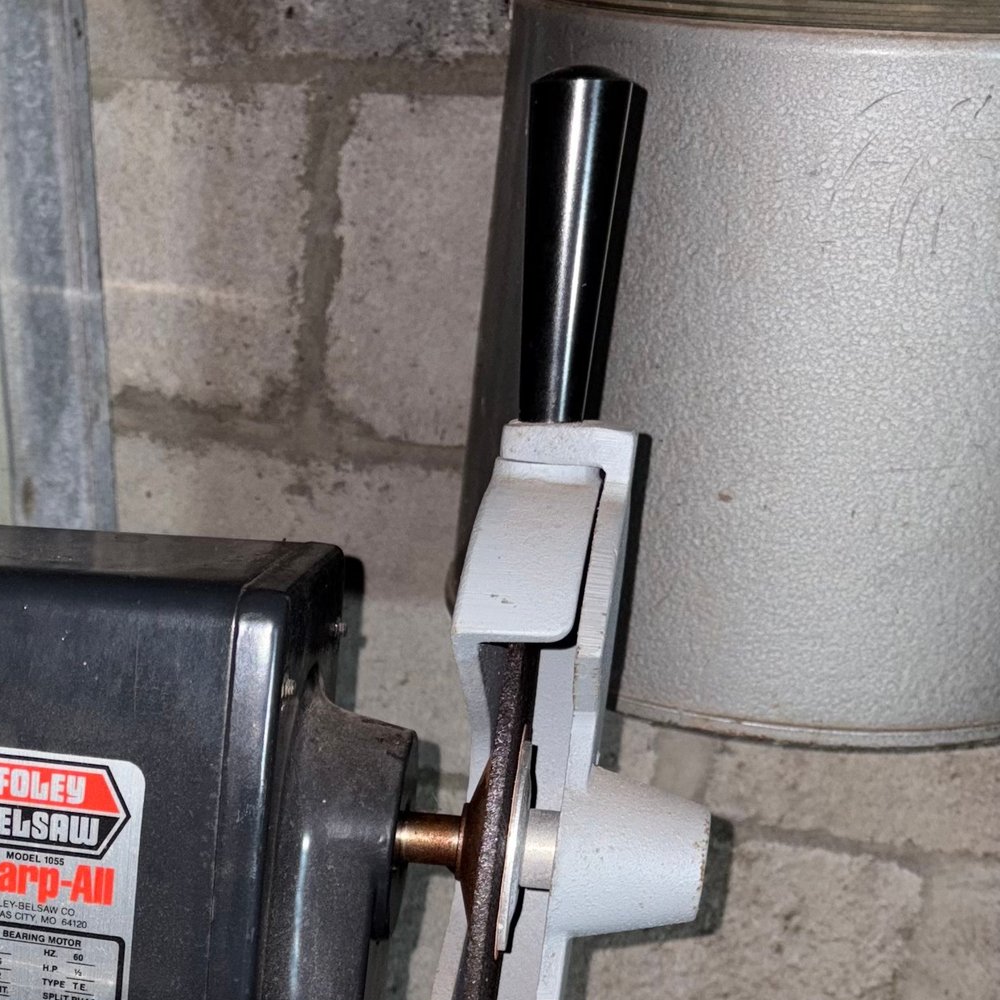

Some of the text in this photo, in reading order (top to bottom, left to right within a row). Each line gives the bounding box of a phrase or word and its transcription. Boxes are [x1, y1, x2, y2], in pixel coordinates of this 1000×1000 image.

[6, 851, 65, 866] MODEL 1055
[61, 919, 88, 929] 64120
[2, 930, 45, 943] BEARING
[48, 936, 82, 948] MOTOR
[73, 953, 84, 962] 60
[42, 978, 66, 989] TYPE
